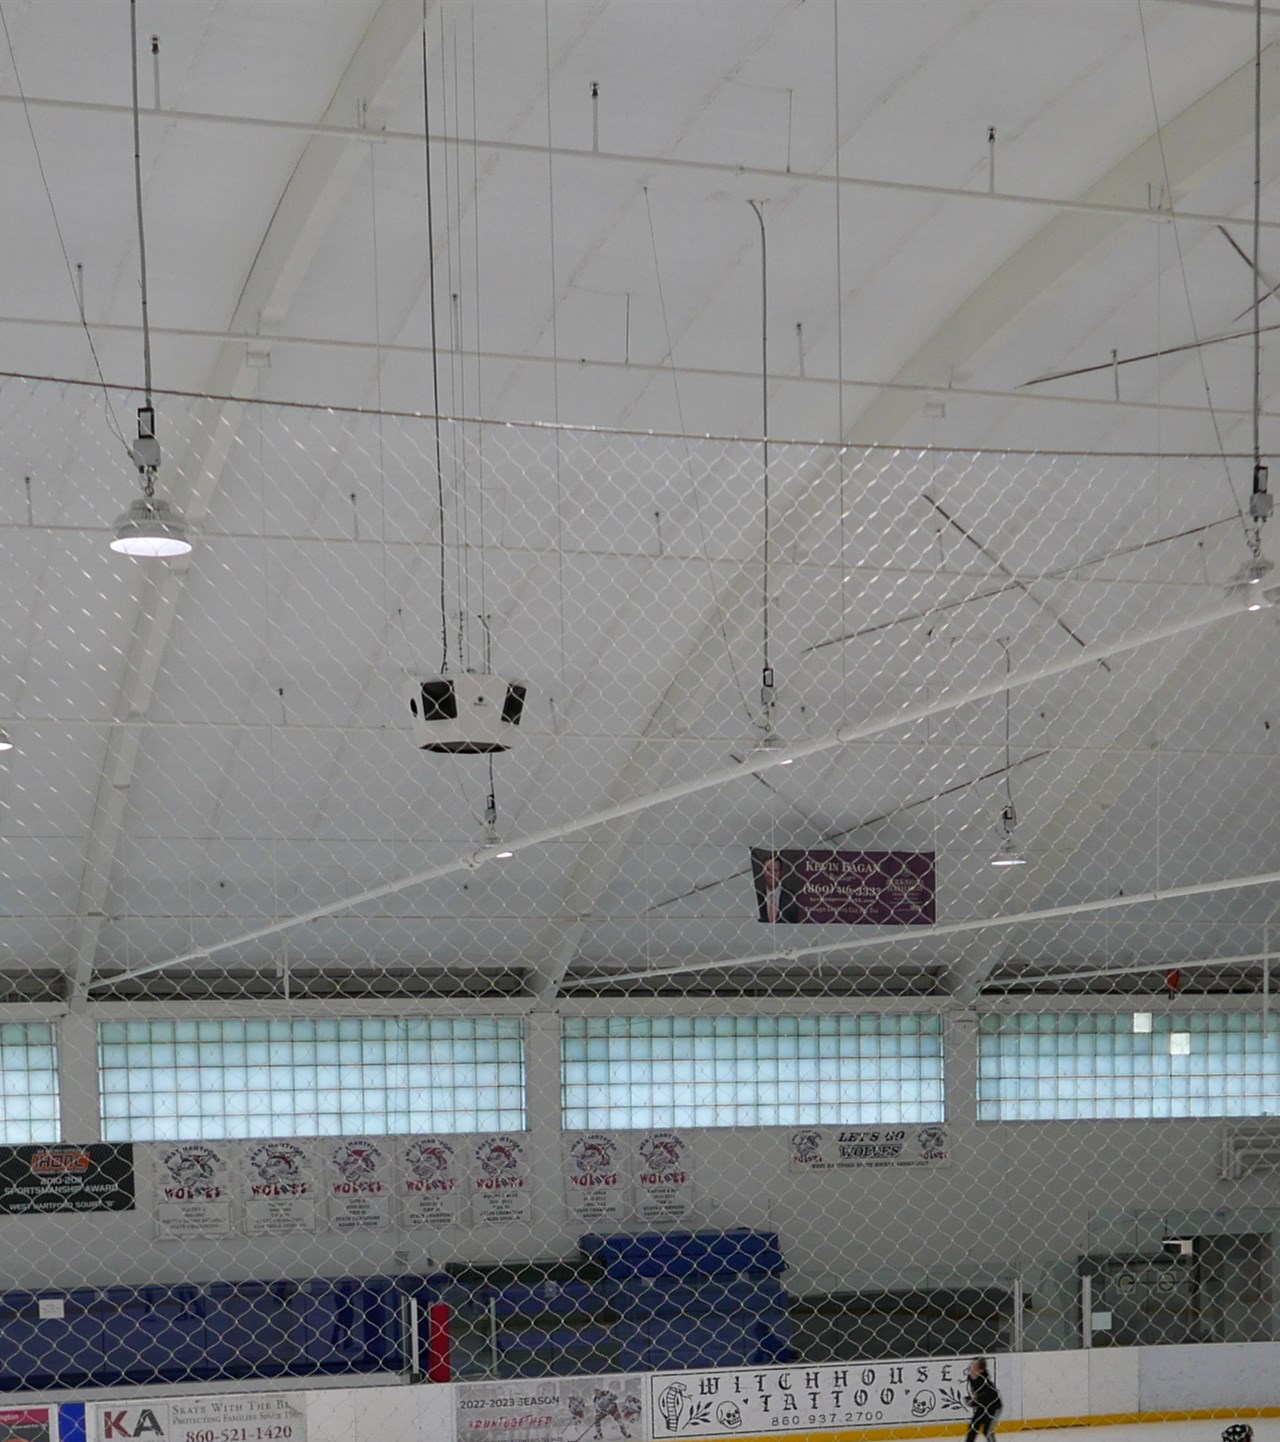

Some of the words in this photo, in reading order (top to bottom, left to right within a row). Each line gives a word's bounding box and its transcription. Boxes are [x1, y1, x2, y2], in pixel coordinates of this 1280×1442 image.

[461, 1399, 515, 1410] 2022-2023
[517, 1396, 560, 1407] SEASON
[760, 1387, 895, 1413] TATTOO
